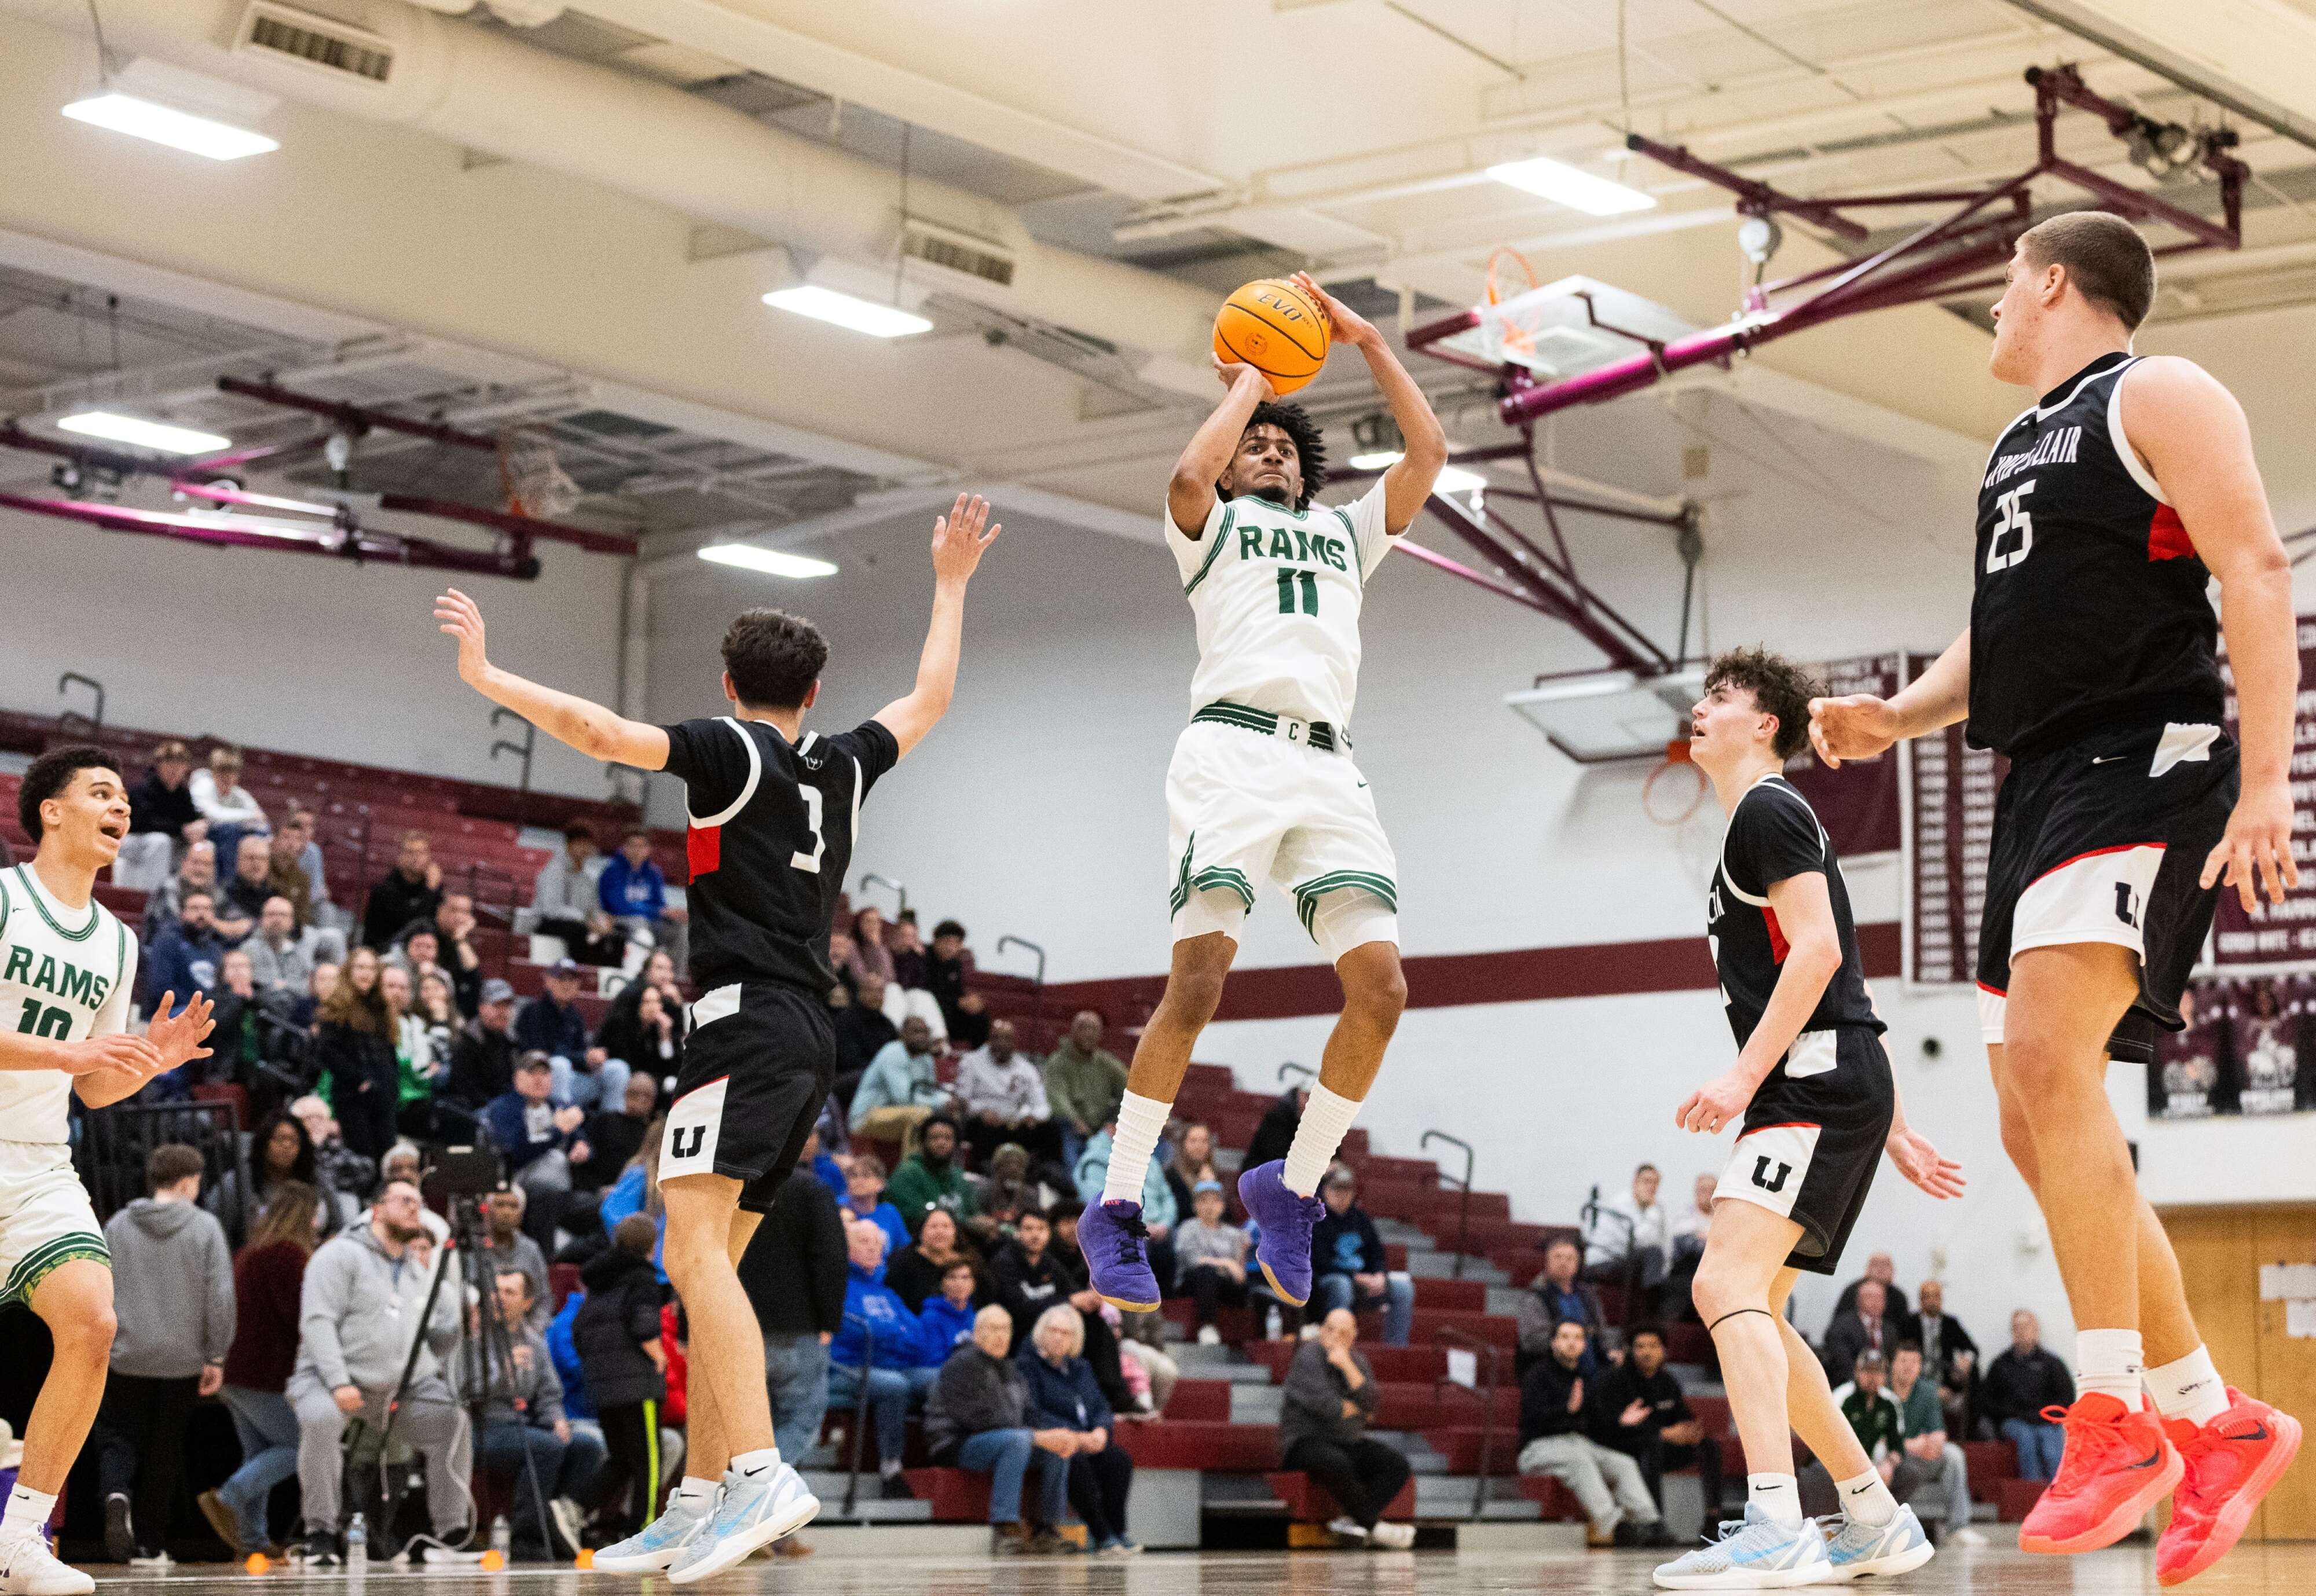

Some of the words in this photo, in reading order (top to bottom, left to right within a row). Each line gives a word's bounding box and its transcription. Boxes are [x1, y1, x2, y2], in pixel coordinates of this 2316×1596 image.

[1257, 293, 1302, 321] EVO
[1236, 524, 1347, 572] RAMS
[1986, 479, 2037, 574] 25
[1277, 567, 1318, 618] 11
[1288, 722, 1299, 740] C
[790, 783, 826, 874] 3
[3, 944, 109, 1011] RAMS
[671, 1125, 706, 1159] U
[1751, 1155, 1793, 1193] U
